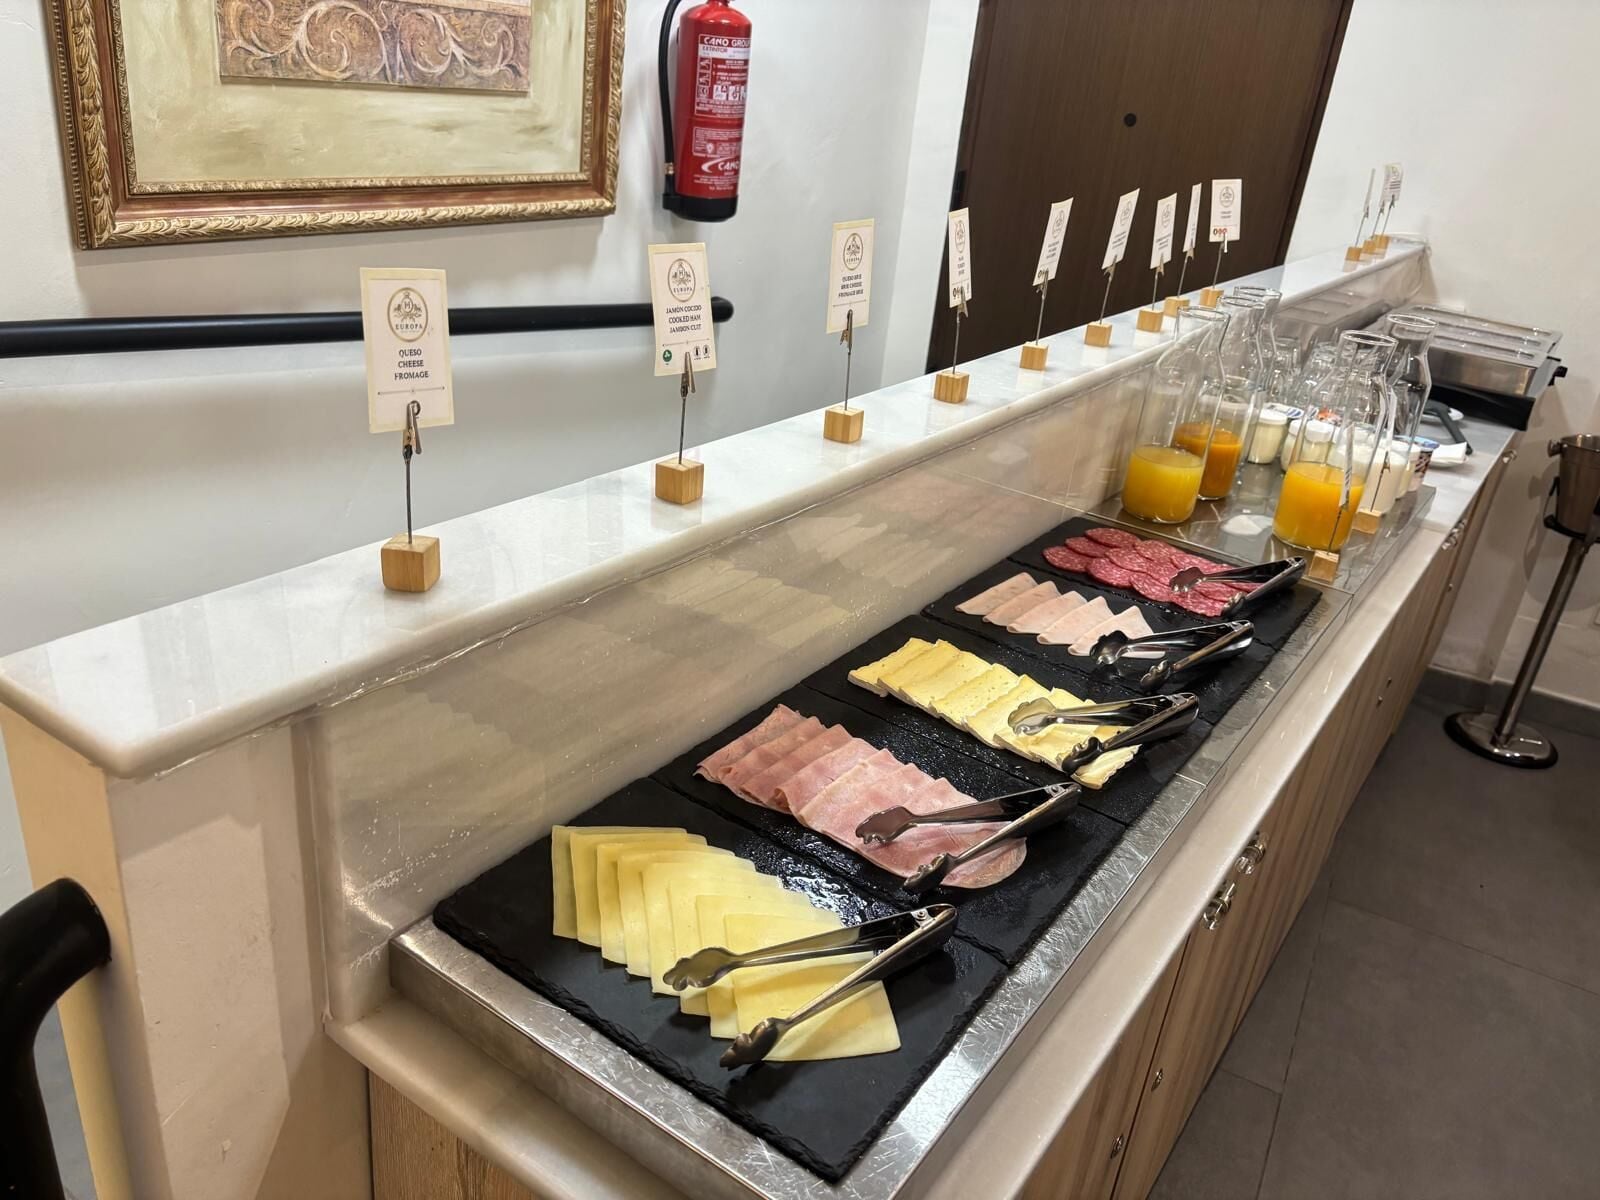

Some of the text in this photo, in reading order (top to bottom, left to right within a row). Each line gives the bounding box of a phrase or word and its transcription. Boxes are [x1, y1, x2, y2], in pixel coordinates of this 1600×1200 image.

[703, 36, 729, 46] CANO
[666, 305, 684, 314] JAMÓN
[668, 315, 689, 324] COOKED
[669, 325, 690, 334] JAMBON
[398, 348, 422, 358] QUESO
[398, 359, 424, 368] CHEESE
[394, 370, 429, 380] FROMAGE
